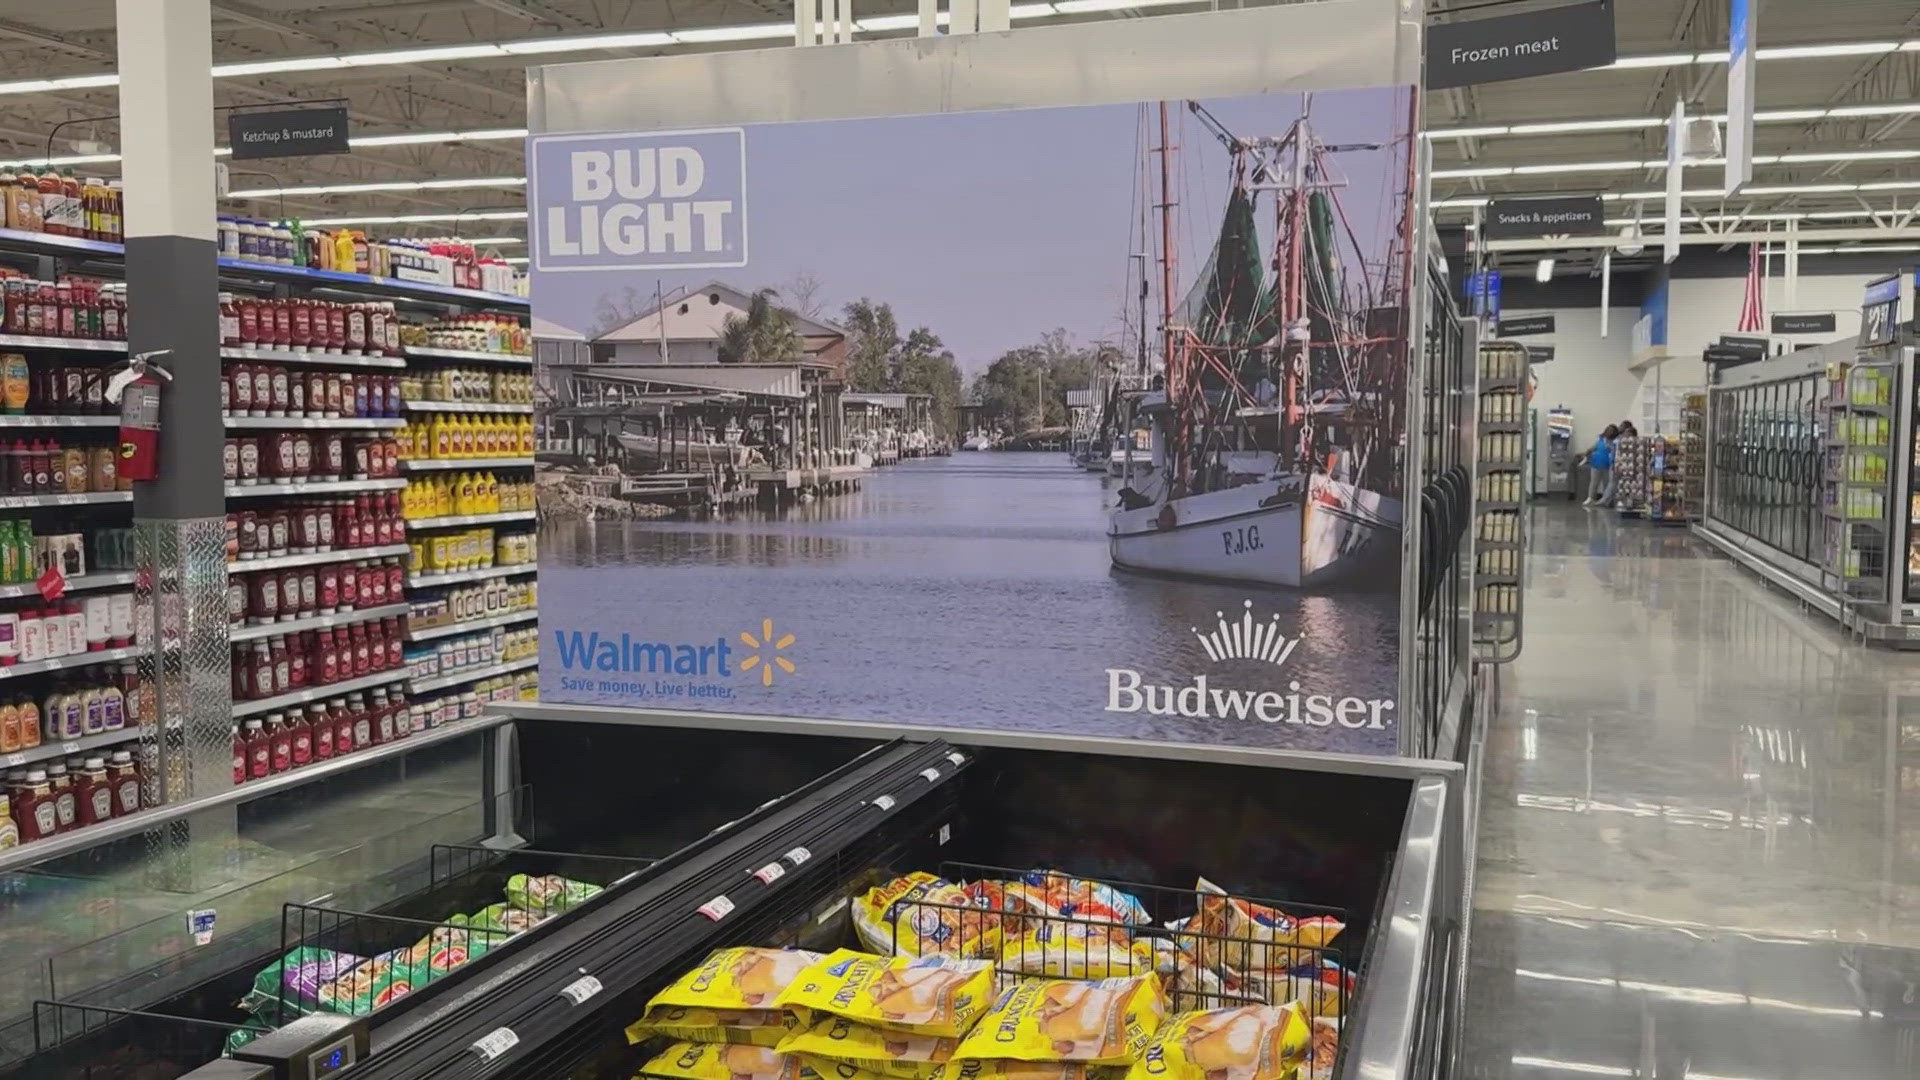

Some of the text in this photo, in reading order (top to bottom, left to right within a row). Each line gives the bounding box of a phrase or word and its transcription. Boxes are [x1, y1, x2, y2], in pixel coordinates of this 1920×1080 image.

[1451, 36, 1559, 64] Frozen meat
[242, 126, 334, 143] Ketchup & mustard
[571, 147, 705, 202] BUD
[548, 201, 732, 256] LIGHT
[1498, 211, 1592, 225] Snacks & appetizers
[555, 630, 732, 677] Walmart
[561, 677, 737, 699] Save money. Live better.
[1104, 668, 1395, 730] Budweiser
